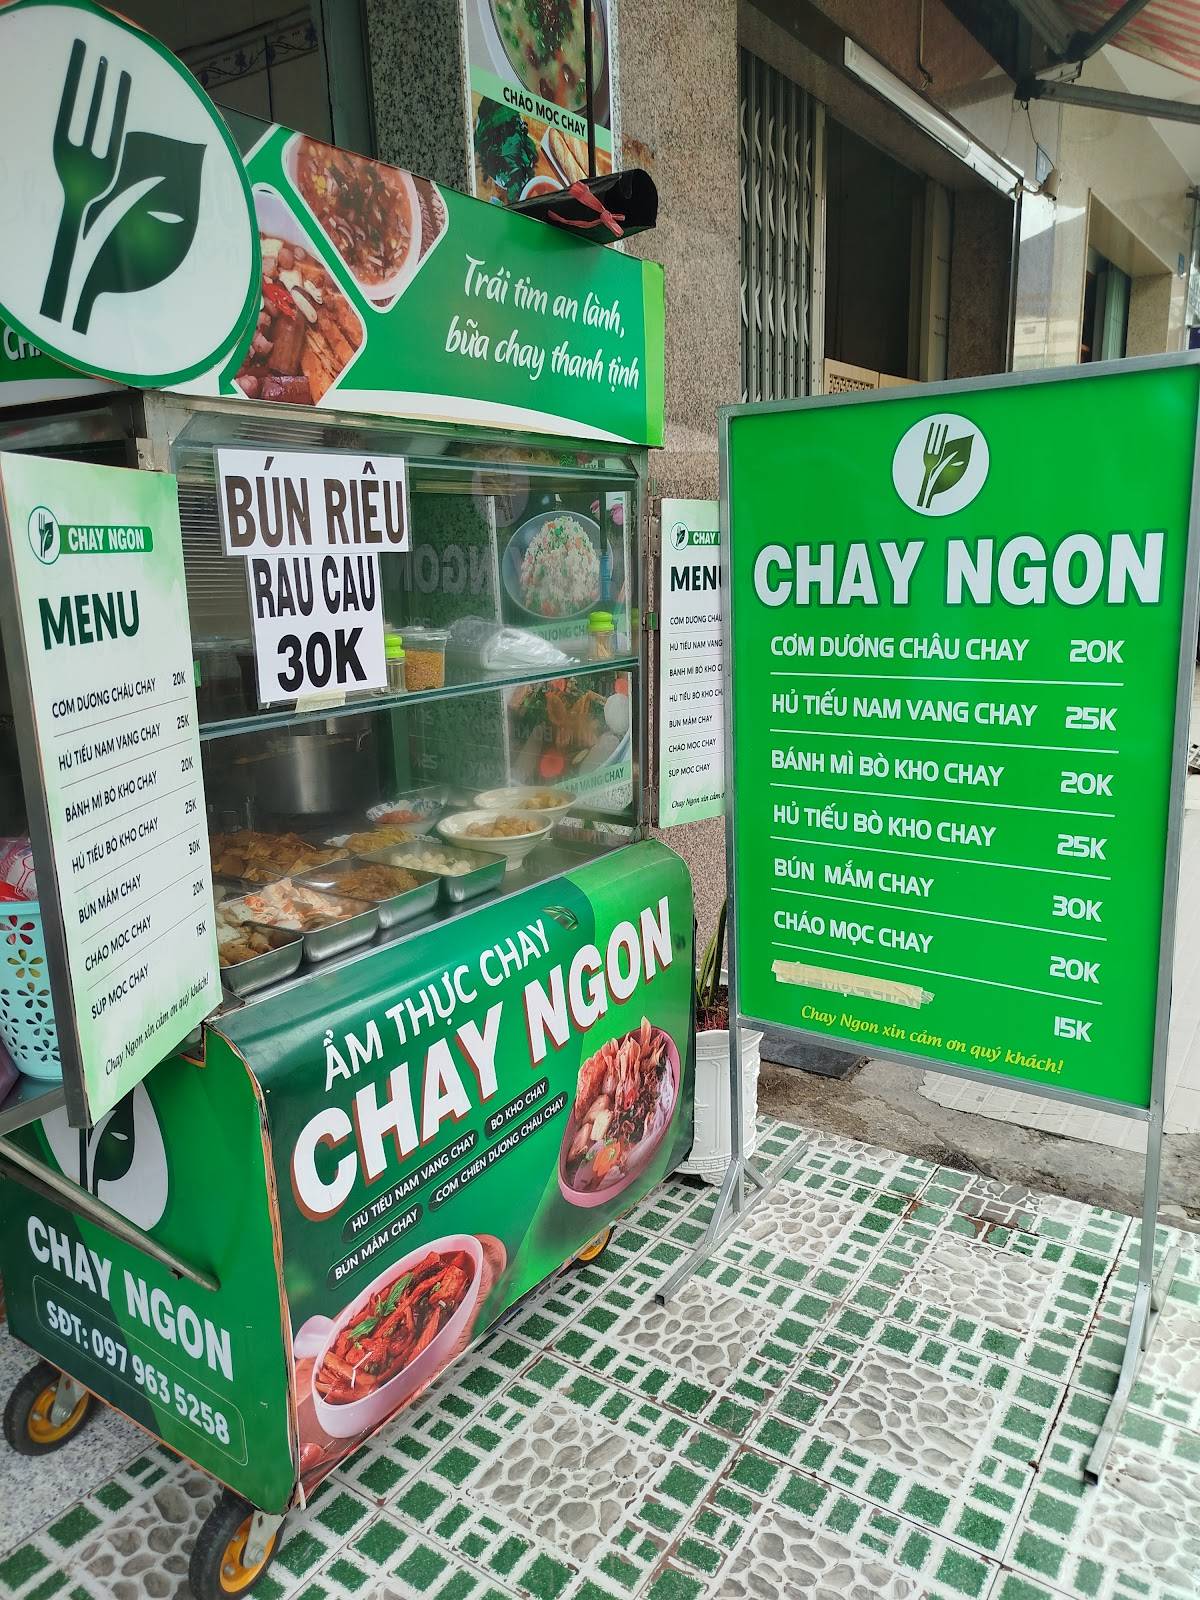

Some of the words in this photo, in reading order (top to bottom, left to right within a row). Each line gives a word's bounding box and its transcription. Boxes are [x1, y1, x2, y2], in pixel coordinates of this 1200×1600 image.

[503, 87, 533, 112] CHÁO
[536, 101, 560, 125] MỌC
[561, 115, 585, 137] CHAY
[464, 253, 510, 304] Trái
[514, 277, 548, 314] tim
[553, 295, 578, 322] an
[583, 292, 625, 338] lành,
[445, 315, 489, 360] bữa
[495, 329, 545, 381] chay
[551, 341, 604, 383] thanh
[607, 356, 639, 393] tịnh
[225, 457, 312, 548] BÚN
[323, 461, 405, 544] RIÊU
[68, 528, 104, 550] CHAY
[108, 528, 145, 550] NGON
[693, 532, 715, 544] CHAY
[753, 541, 925, 607] CHAY
[946, 532, 1165, 606] NGON
[252, 557, 313, 618] RAU
[321, 555, 376, 614] CAU
[38, 590, 140, 650] MENU
[693, 641, 705, 649] NAM
[771, 634, 814, 657] CƠM
[820, 634, 894, 658] DƯƠNG
[899, 632, 960, 659] CHÂU
[965, 638, 1029, 662] CHAY
[1070, 639, 1125, 664] 20K
[277, 627, 367, 692] 30K
[52, 699, 75, 718] CƠM
[77, 691, 110, 712] DƯƠNG
[111, 683, 134, 701] CHÂU
[135, 678, 156, 695] CHAY
[173, 671, 186, 686] 20K
[698, 715, 712, 723] CHAY
[772, 689, 798, 715] HỦ
[803, 687, 847, 716] TIẾU
[853, 697, 901, 719] NAM
[906, 699, 969, 724] VANG
[974, 702, 1037, 727] CHAY
[1065, 706, 1117, 731] 25K
[59, 750, 72, 771] HỦ
[74, 744, 92, 765] TIẾU
[94, 739, 114, 758] NAM
[116, 730, 139, 750] VANG
[141, 723, 160, 742] CHAY
[177, 714, 189, 729] 25K
[605, 767, 624, 783] CHAY
[696, 763, 710, 772] CHAY
[702, 738, 716, 747] CHAY
[771, 746, 825, 773] BÁNH
[831, 750, 853, 775] MÌ
[859, 753, 889, 778] BÒ
[895, 759, 938, 780] KHO
[944, 763, 1004, 787] CHAY
[1061, 771, 1114, 796] 20K
[65, 799, 90, 822] BÁNH
[104, 785, 116, 805] BÒ
[117, 780, 135, 799] KHO
[137, 771, 157, 791] CHAY
[181, 757, 193, 772] 20K
[72, 852, 85, 874] HỦ
[87, 842, 104, 864] TIẾU
[106, 835, 118, 855] BÒ
[119, 828, 137, 848] KHO
[138, 817, 158, 838] CHAY
[185, 798, 197, 814] 25K
[773, 800, 799, 825] HỦ
[804, 803, 848, 830] TIẾU
[853, 808, 883, 835] BÒ
[888, 817, 931, 840] KHO
[937, 822, 996, 847] CHAY
[1057, 834, 1107, 860] 25K
[78, 902, 96, 924] BÚN
[121, 874, 141, 897] CHAY
[189, 840, 200, 855] 30K
[774, 855, 814, 881] BÚN
[824, 861, 873, 890] MẮM
[878, 872, 934, 897] CHAY
[1052, 896, 1103, 923] 30K
[85, 945, 109, 971] CHÁO
[110, 930, 130, 952] MỌC
[131, 915, 151, 939] CHAY
[193, 879, 204, 896] 20K
[773, 906, 825, 935] CHÁO
[830, 919, 874, 945] MỌC
[878, 928, 933, 954] CHAY
[1049, 955, 1100, 984] 20K
[91, 997, 106, 1019] SÚP
[108, 980, 128, 1006] MỌC
[129, 963, 149, 989] CHAY
[196, 920, 206, 936] 15K
[324, 1018, 384, 1092] ẨM
[385, 964, 477, 1045] THỰC
[479, 918, 550, 987] CHAY
[1053, 1016, 1092, 1042] 15K
[106, 1052, 123, 1075] Chay
[125, 1036, 143, 1058] Ngon
[144, 1023, 155, 1040] xin
[292, 1000, 503, 1216] CHAY
[524, 895, 673, 1064] NGON
[801, 1005, 836, 1026] Chay
[840, 1013, 879, 1033] Ngon
[882, 1023, 906, 1040] xin
[947, 1039, 966, 1052] ơn
[970, 1043, 1002, 1062] quý
[1005, 1049, 1064, 1074] khách!
[491, 1113, 503, 1130] BÒ
[506, 1100, 523, 1119] KHO
[525, 1082, 546, 1104] CHAY
[436, 1178, 458, 1202] CƠM
[461, 1157, 486, 1182] CHIÊN
[488, 1132, 520, 1162] DƯƠNG
[521, 1115, 542, 1137] CHÂU
[544, 1097, 564, 1119] CHAY
[352, 1210, 369, 1232] HỦ
[370, 1194, 393, 1217] TIẾU
[395, 1175, 420, 1200] NAM
[421, 1154, 449, 1180] VANG
[451, 1134, 475, 1158] CHAY
[335, 1257, 359, 1280] BÚN
[362, 1231, 389, 1260] MẮM
[391, 1209, 418, 1236] CHAY
[27, 1215, 113, 1301] CHAY
[124, 1269, 234, 1381] NGON
[47, 1300, 89, 1348] SĐT:
[91, 1327, 127, 1373] 097
[131, 1353, 171, 1403] 963
[174, 1381, 230, 1445] 5258
